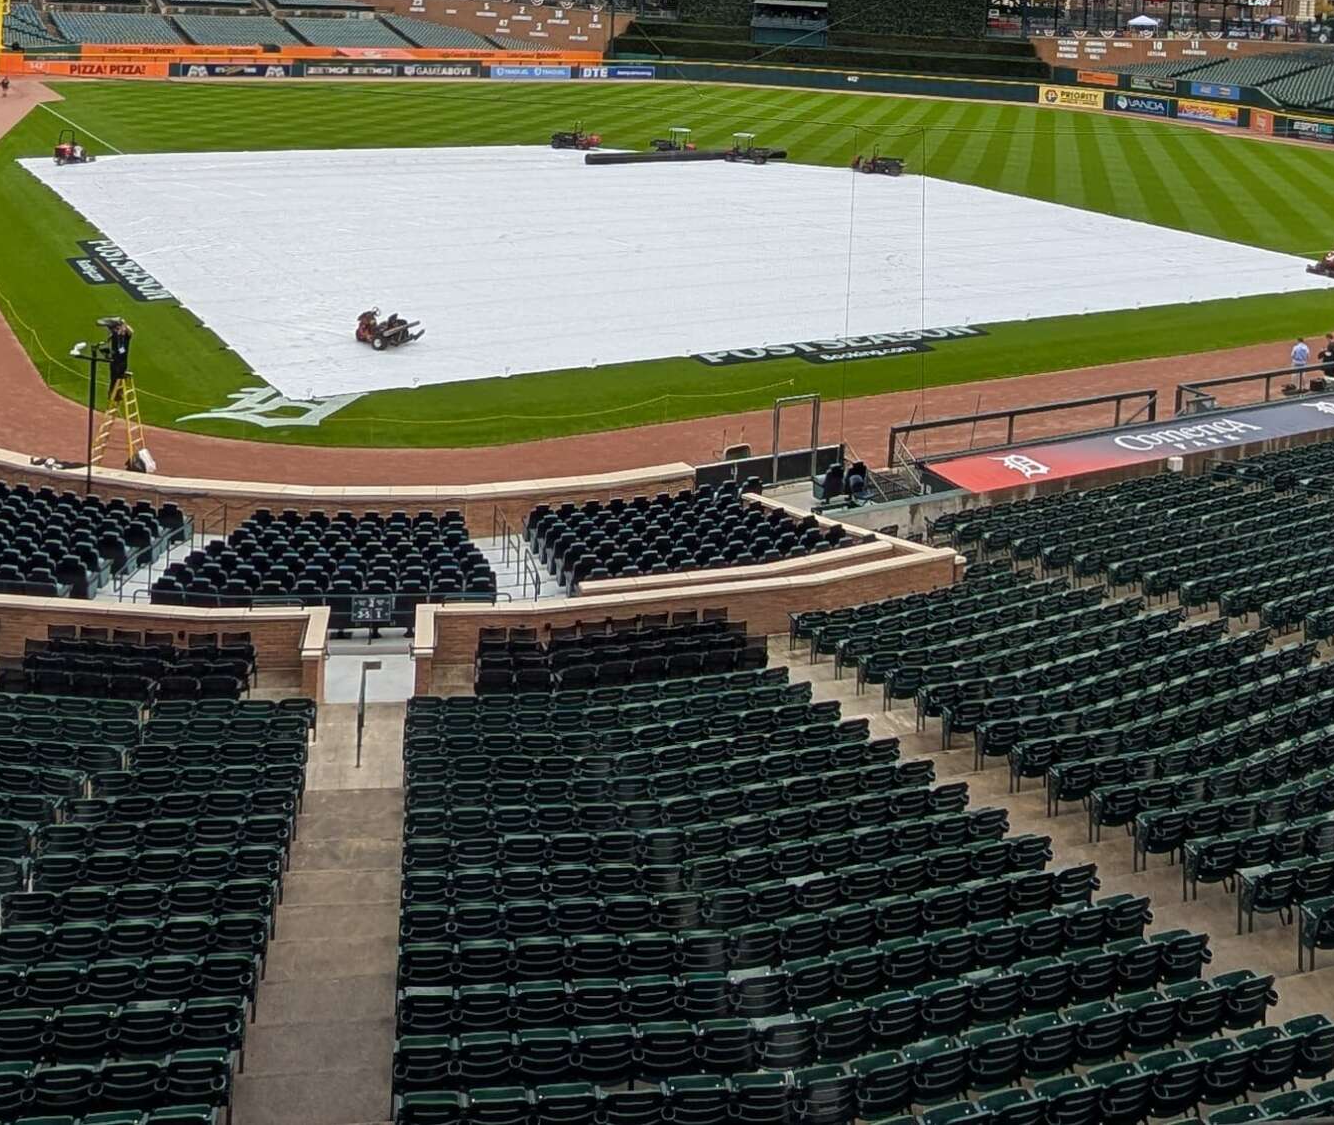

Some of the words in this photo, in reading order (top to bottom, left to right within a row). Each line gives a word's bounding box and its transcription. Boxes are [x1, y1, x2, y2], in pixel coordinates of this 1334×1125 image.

[1153, 41, 1163, 50] 10
[1191, 41, 1199, 49] 11
[1226, 42, 1238, 51] 42
[70, 64, 108, 75] PIZZA!
[110, 64, 147, 75] PIZZA!
[417, 67, 471, 75] GAMEABOVE
[583, 68, 608, 78] DTE
[1060, 90, 1099, 101] PRIORITY
[1174, 434, 1241, 451] PARK
